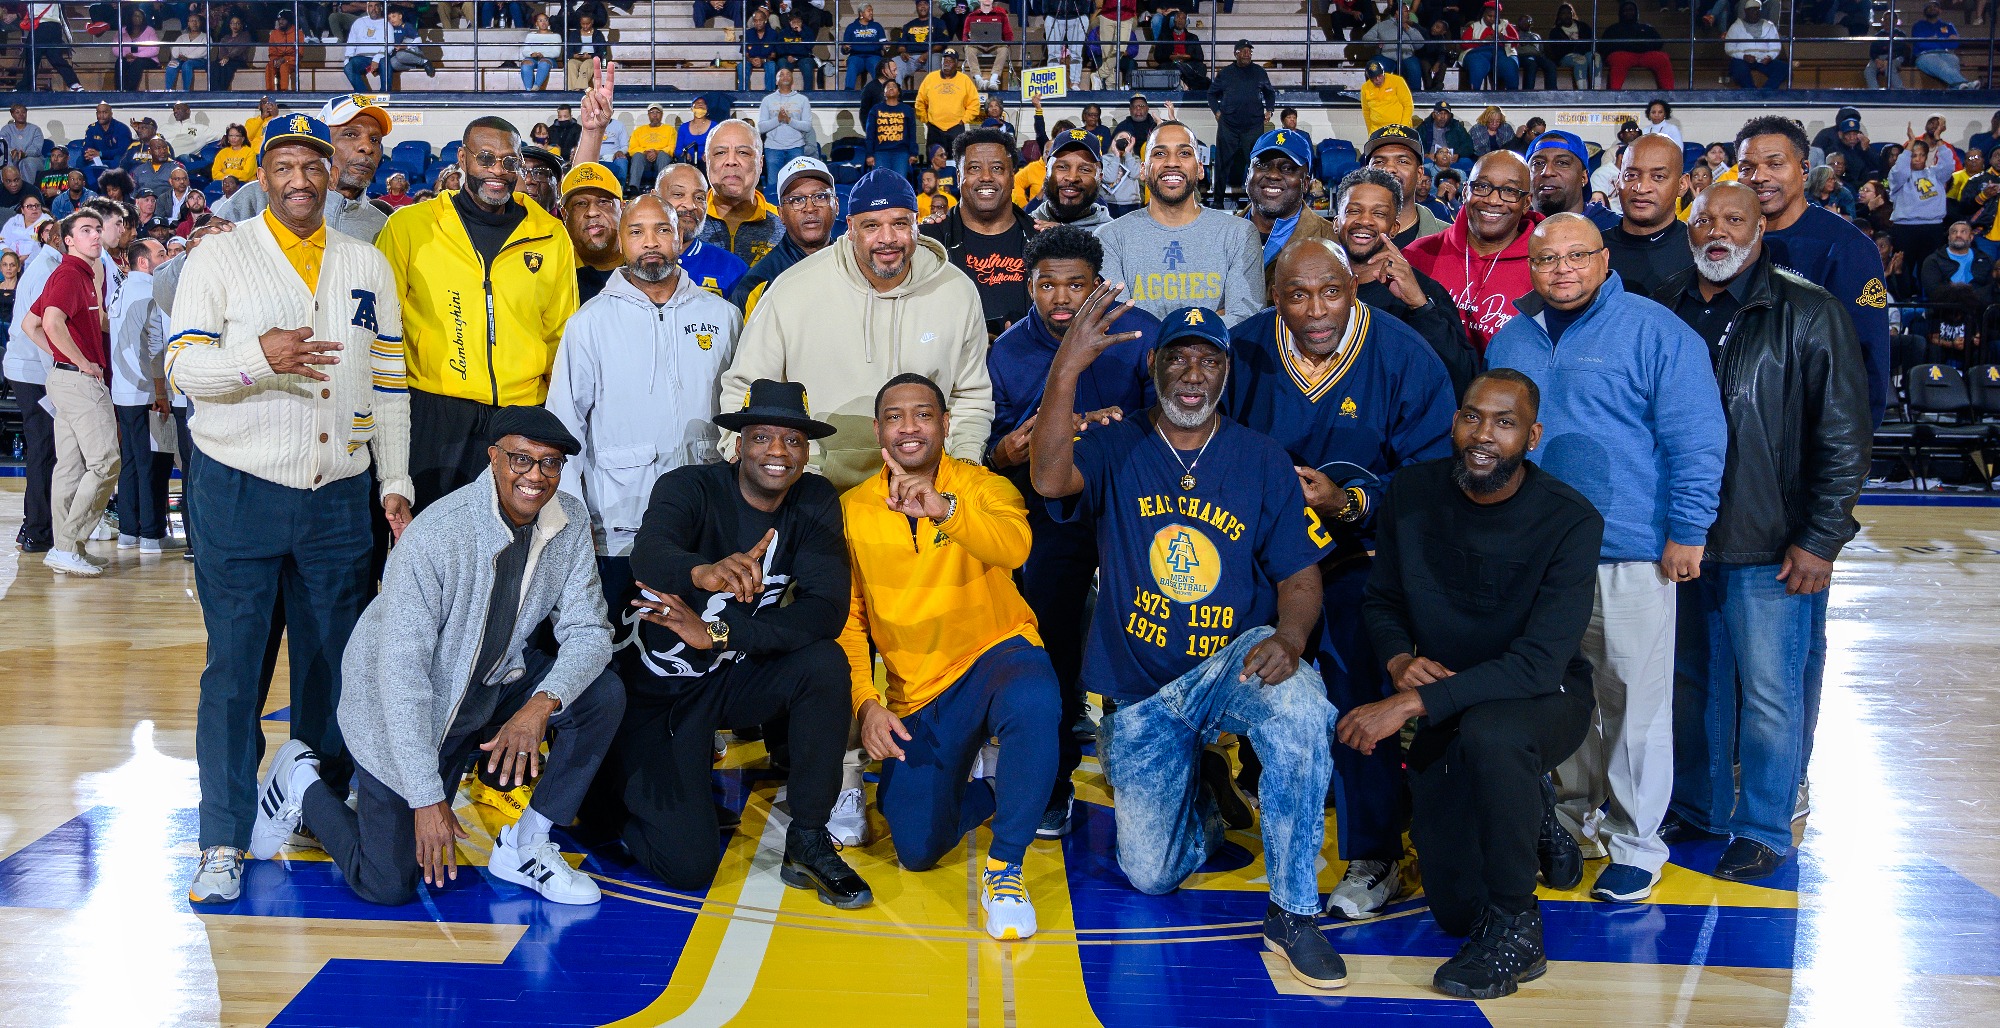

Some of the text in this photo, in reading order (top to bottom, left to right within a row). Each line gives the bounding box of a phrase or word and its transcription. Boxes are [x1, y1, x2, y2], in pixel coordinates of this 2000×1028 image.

[1031, 70, 1056, 84] Aggie
[1028, 82, 1058, 97] Pride!
[889, 117, 904, 125] the
[1557, 114, 1587, 122] SECTION
[877, 124, 904, 134] aggie
[878, 133, 903, 144] pride!
[977, 271, 1024, 286] Authentic
[1132, 272, 1221, 300] AGGIES
[1480, 293, 1515, 329] Digg
[447, 289, 467, 381] Lamborghini
[684, 322, 720, 335] NC A&T
[1468, 321, 1494, 335] KAPPA
[1177, 496, 1246, 542] CHAMPS
[1159, 576, 1208, 593] BASKETBALL
[1170, 573, 1196, 584] MEN'S
[1133, 585, 1234, 629] 1975 1978
[1125, 612, 1168, 648] 1976
[501, 792, 521, 810] JUST SO
